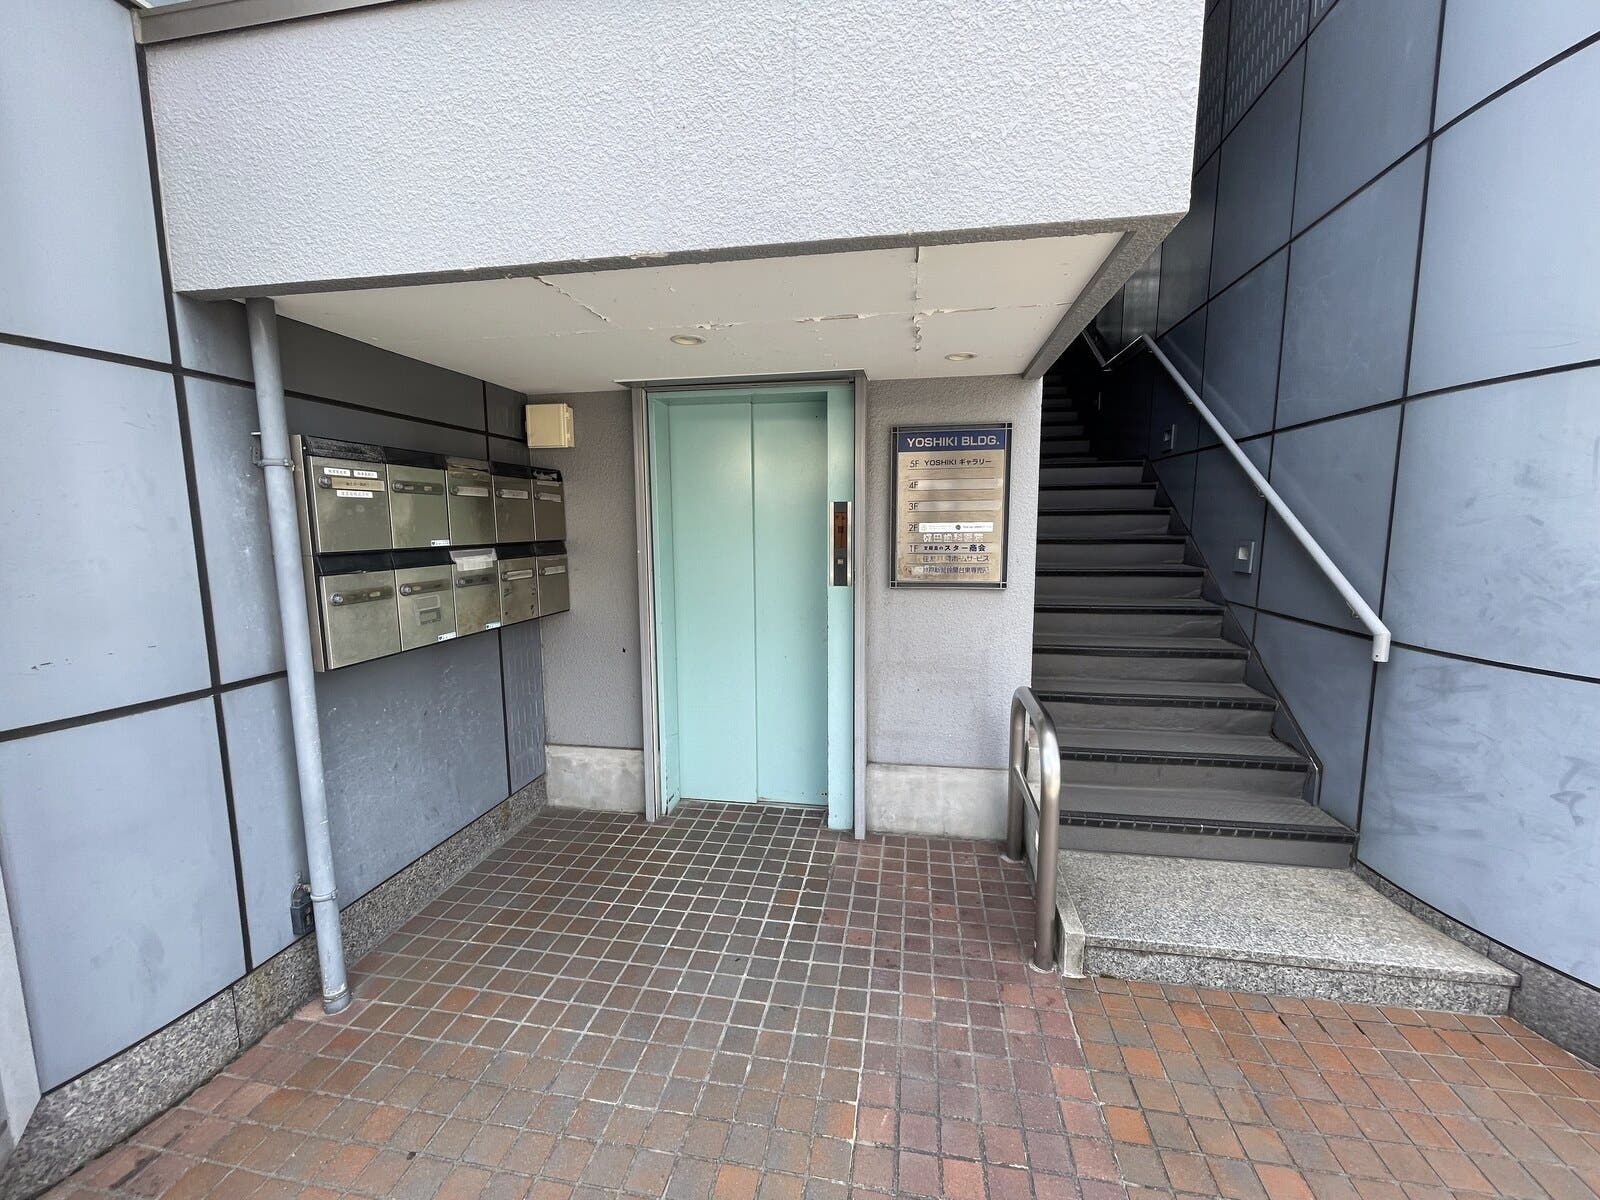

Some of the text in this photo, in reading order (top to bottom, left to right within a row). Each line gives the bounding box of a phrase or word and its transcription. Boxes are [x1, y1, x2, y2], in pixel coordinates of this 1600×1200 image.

[907, 435, 1000, 448] YOSHIKI BLDG.
[909, 459, 919, 468] 5F
[908, 481, 919, 489] 4F
[908, 502, 919, 511] 3F
[908, 523, 918, 532] 2F
[909, 544, 919, 553] 1F
